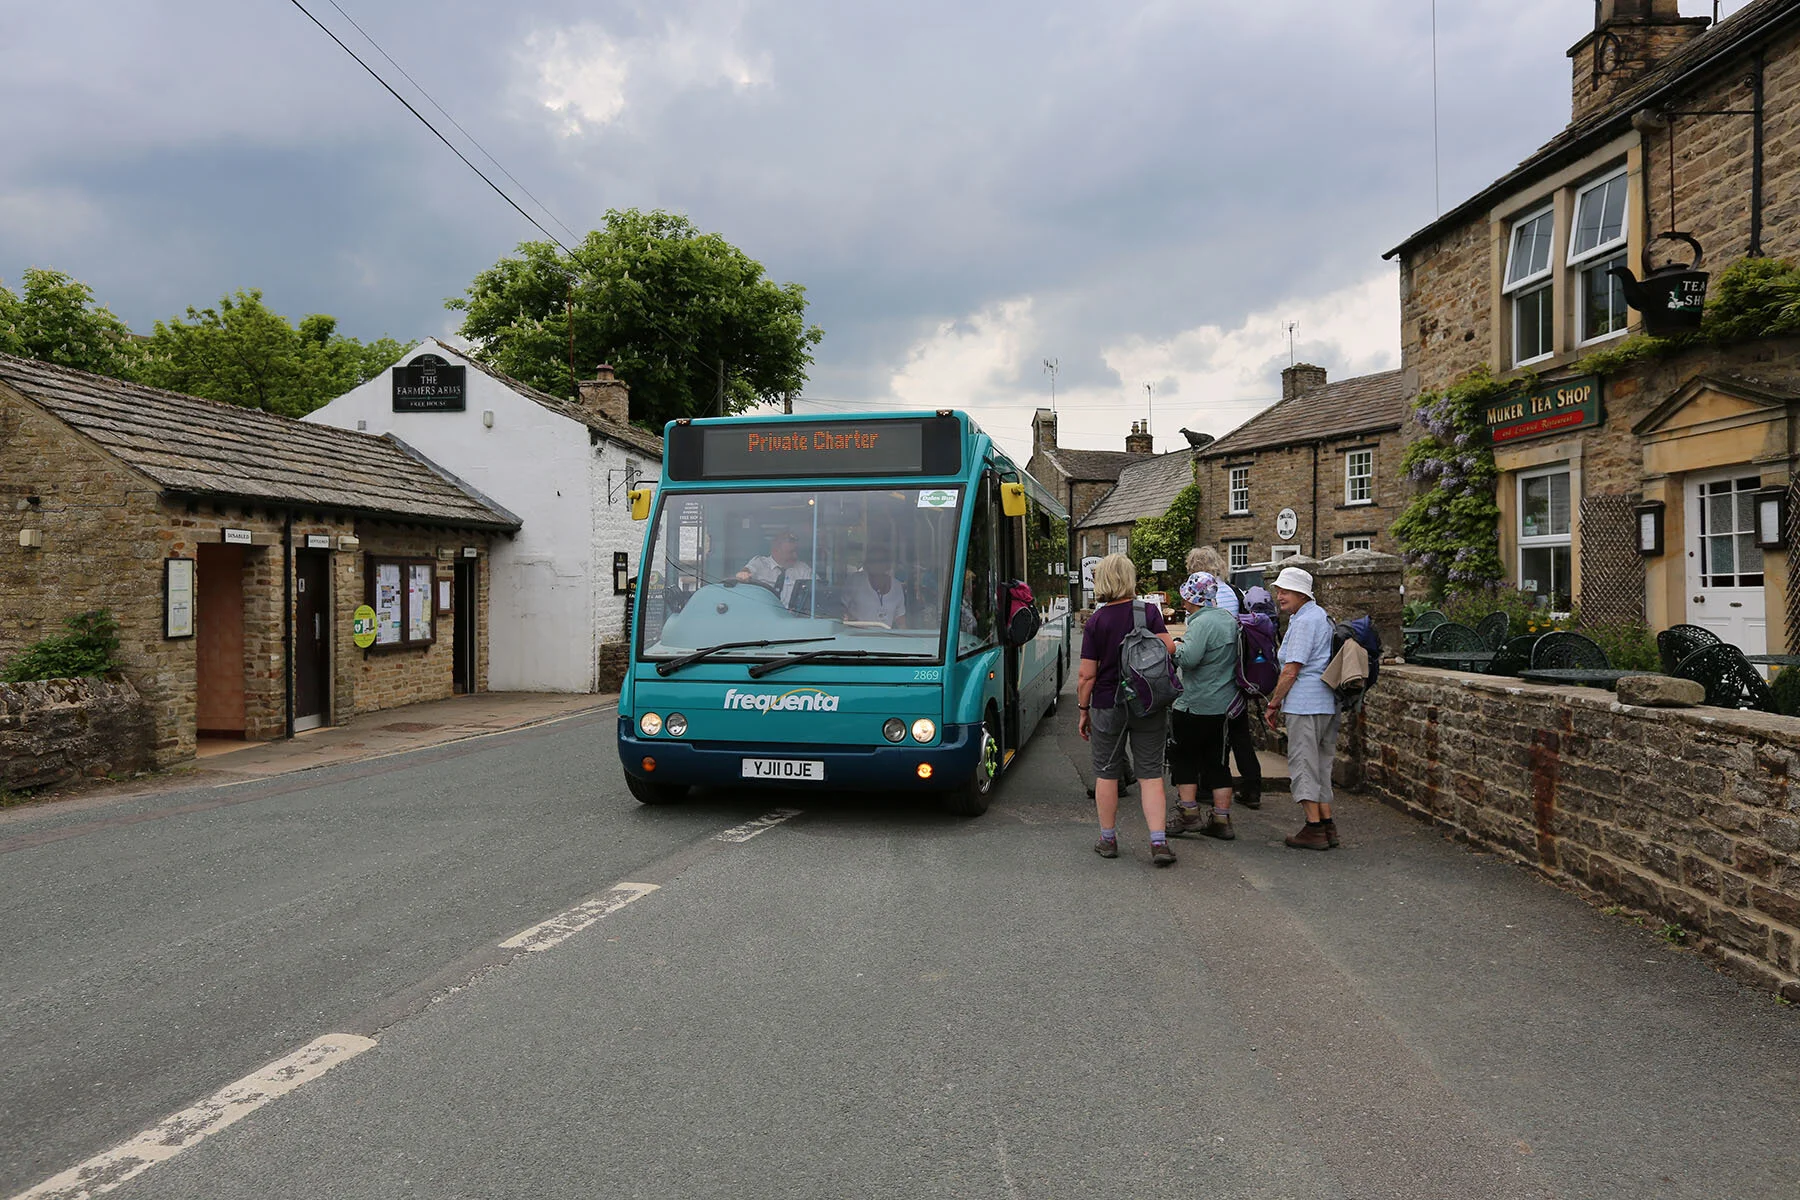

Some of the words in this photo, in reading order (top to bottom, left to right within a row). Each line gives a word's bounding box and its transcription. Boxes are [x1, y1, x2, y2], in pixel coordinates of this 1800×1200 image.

[1682, 280, 1705, 292] TEA
[420, 375, 438, 385] THE
[397, 386, 435, 395] FARMERS
[437, 385, 461, 395] ARMS
[1486, 403, 1524, 425] MUKER
[1530, 396, 1552, 414] TEA
[1557, 385, 1591, 408] SHOP
[748, 432, 808, 452] Private
[813, 430, 879, 450] Charter
[913, 670, 939, 680] 2869
[723, 688, 840, 716] frequenta
[754, 761, 781, 776] YJ11
[784, 763, 812, 777] OJE
